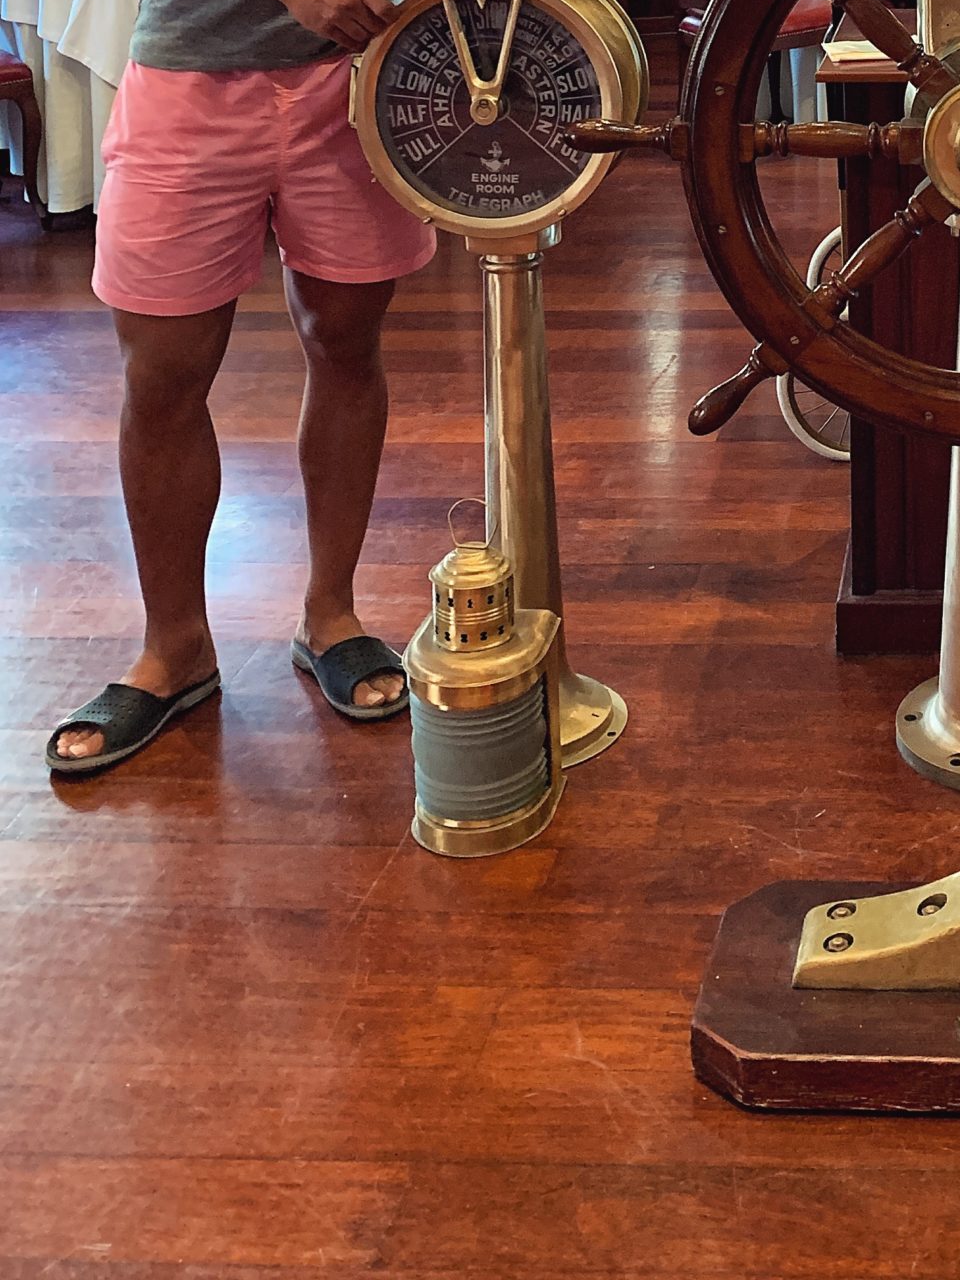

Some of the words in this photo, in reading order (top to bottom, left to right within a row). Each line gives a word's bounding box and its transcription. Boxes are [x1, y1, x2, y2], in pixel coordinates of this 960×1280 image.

[512, 55, 556, 135] ASTERN
[471, 173, 519, 184] ENGINE
[475, 184, 515, 194] ROOM
[447, 186, 546, 211] TELEGRAPH
